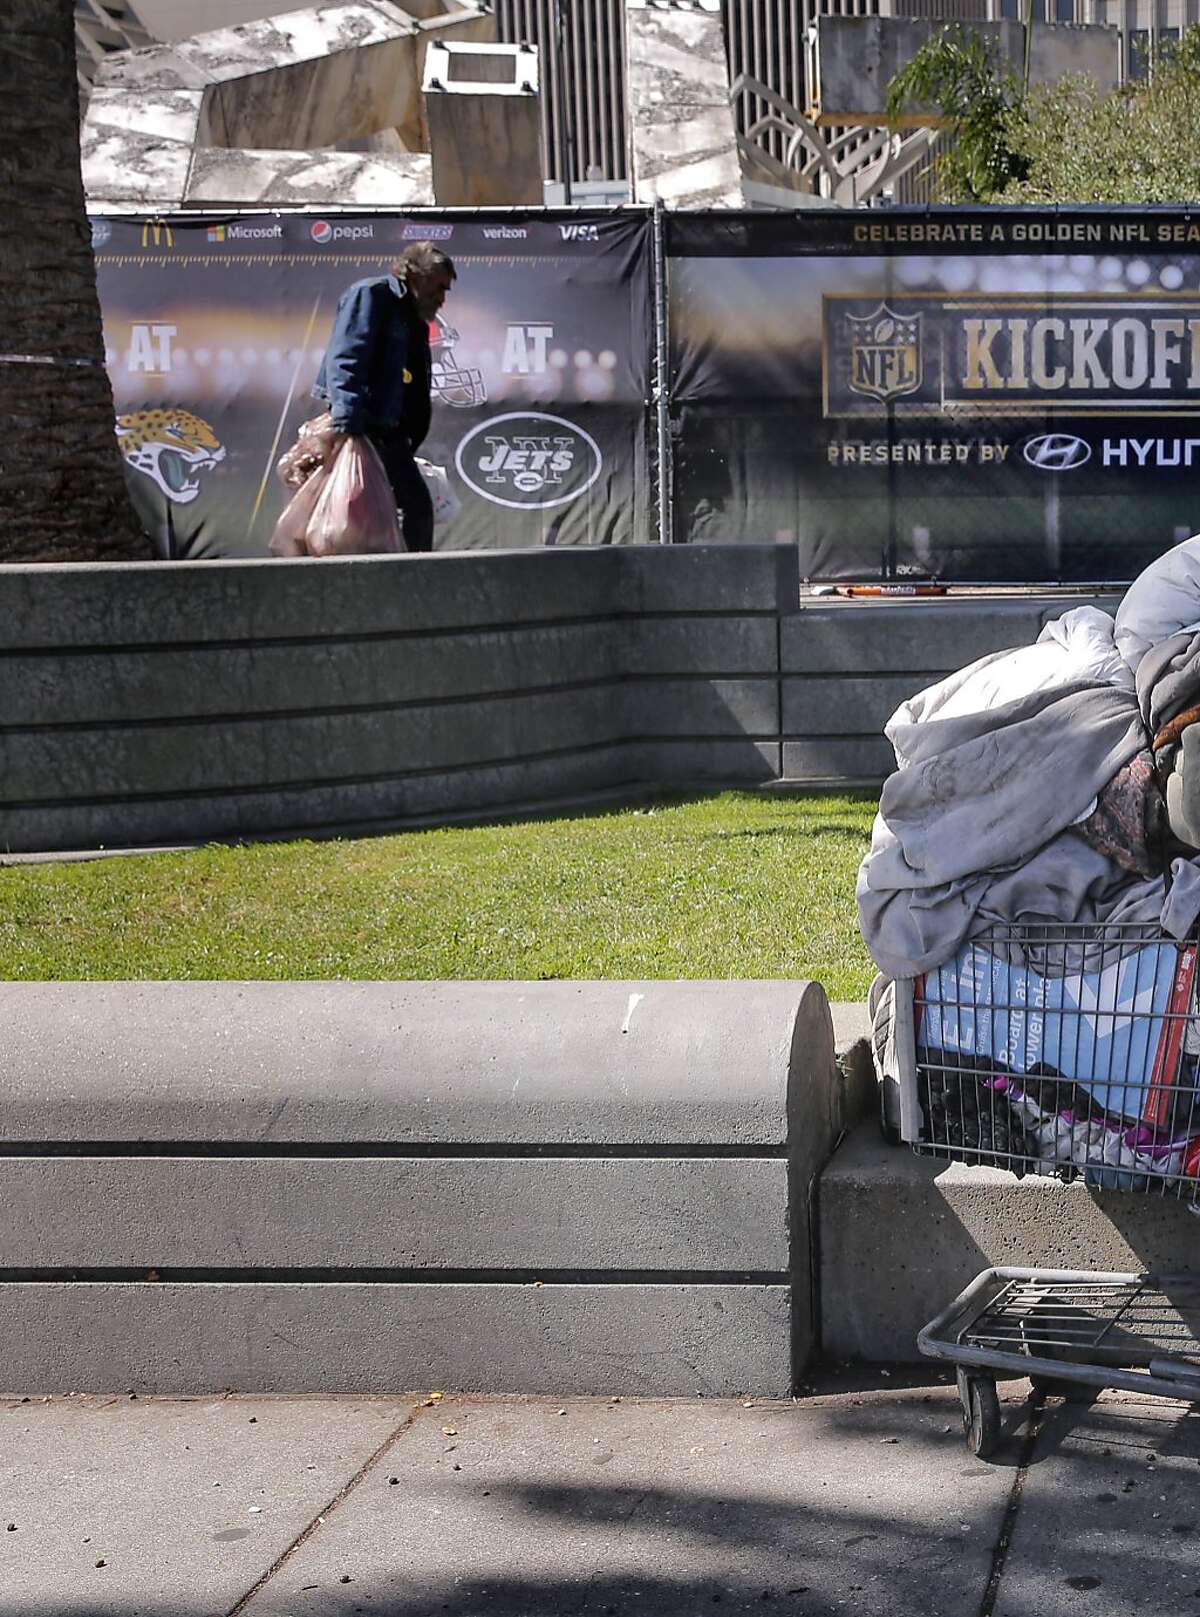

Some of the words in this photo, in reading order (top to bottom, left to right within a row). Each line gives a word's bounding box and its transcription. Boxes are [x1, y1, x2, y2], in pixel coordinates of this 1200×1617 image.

[228, 225, 282, 239] Microsoft
[333, 223, 375, 242] pepsi
[483, 226, 528, 239] verizon
[559, 225, 600, 241] VISA
[853, 224, 983, 242] CELEBRATE
[990, 224, 1005, 241] A
[1012, 224, 1101, 241] GOLDEN
[1110, 224, 1150, 241] NFL
[128, 326, 177, 371] AT
[502, 327, 553, 372] AT
[856, 348, 914, 387] NFL
[478, 444, 574, 471] JETS
[827, 444, 969, 461] PRESENTED
[982, 444, 1010, 461] BY
